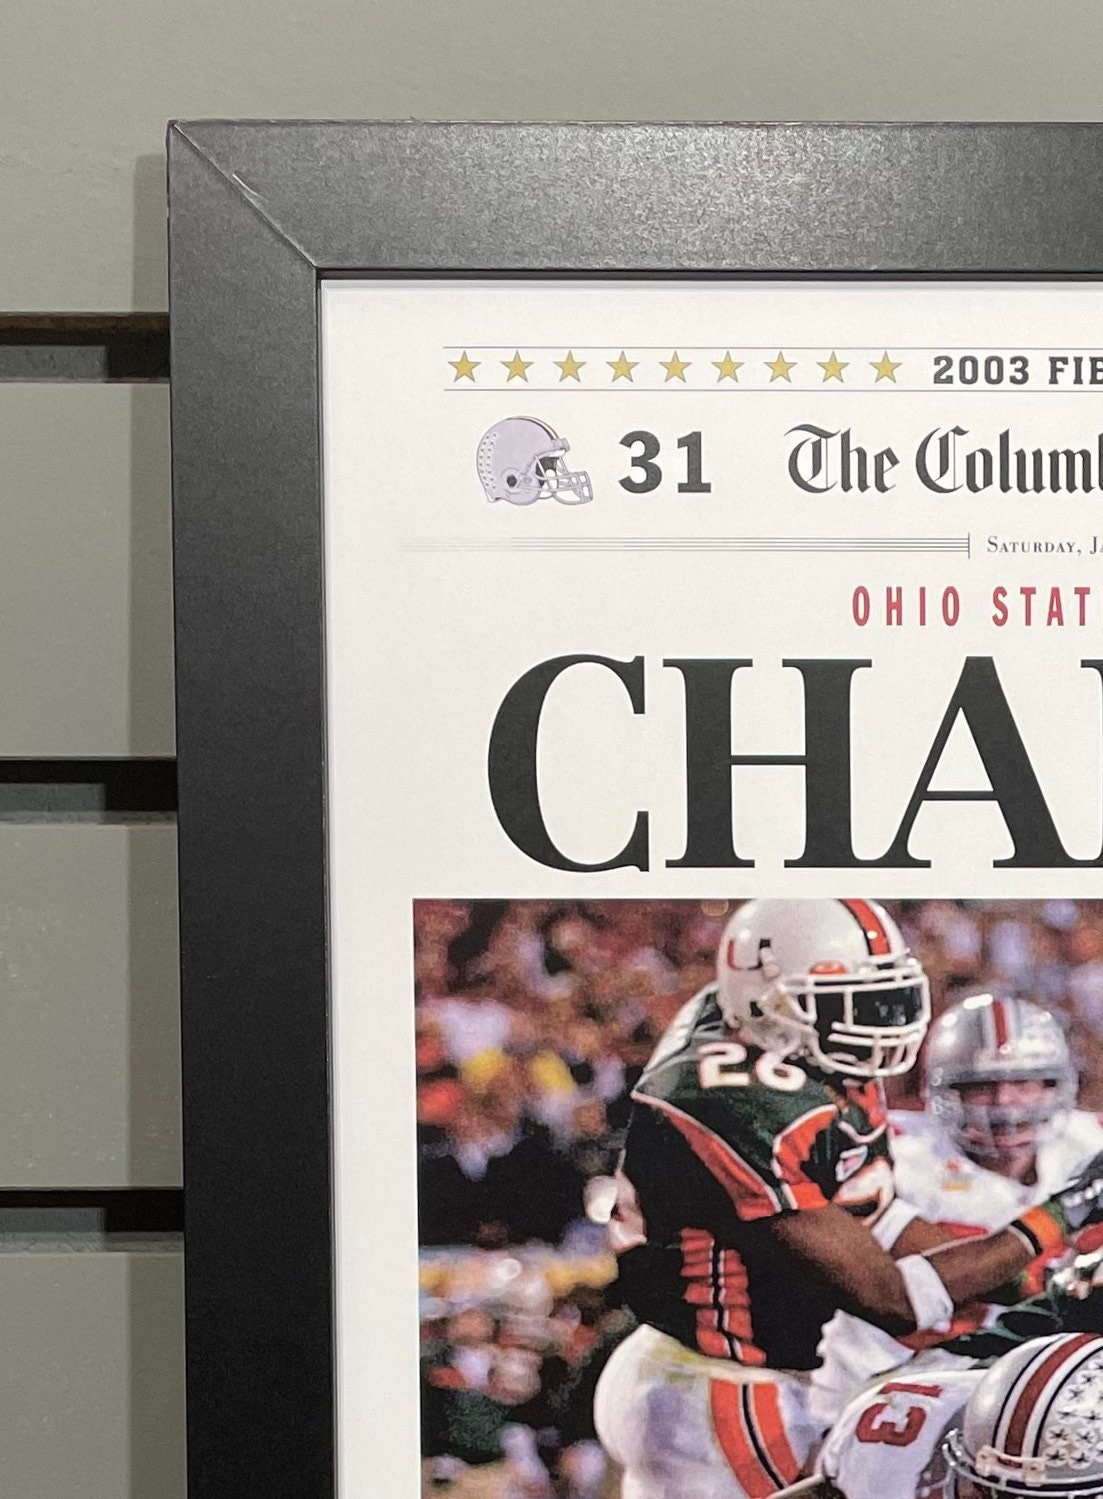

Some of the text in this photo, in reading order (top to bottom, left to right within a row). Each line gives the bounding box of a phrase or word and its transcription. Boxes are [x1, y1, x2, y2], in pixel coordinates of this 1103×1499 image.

[933, 355, 1030, 386] 2003
[618, 430, 712, 495] 31
[784, 423, 900, 494] The
[852, 585, 960, 627] OHIO
[697, 1042, 808, 1092] 26
[854, 1383, 943, 1448] 13
